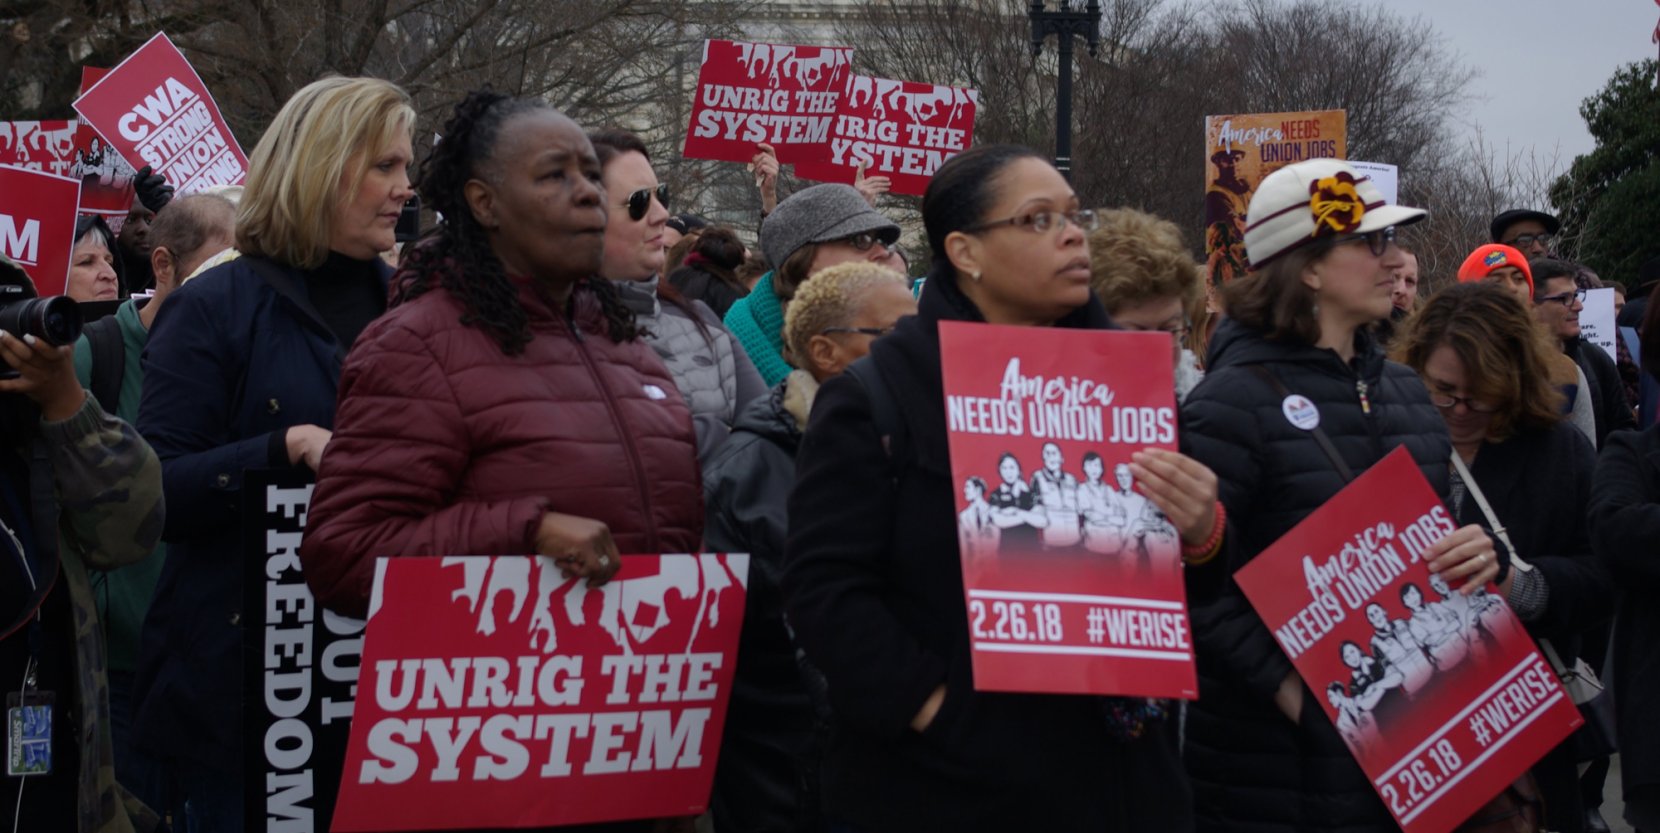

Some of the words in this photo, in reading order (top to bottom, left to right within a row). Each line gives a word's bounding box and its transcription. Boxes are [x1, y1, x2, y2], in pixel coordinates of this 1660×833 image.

[118, 77, 195, 141] CWA
[703, 83, 790, 113] UNRIG
[795, 91, 840, 114] THE
[140, 101, 213, 167] STRONG
[694, 109, 833, 144] SYSTEM
[906, 123, 965, 150] THE
[1218, 119, 1284, 155] America
[1281, 119, 1320, 140] NEEDS
[1261, 142, 1300, 163] UNION
[1305, 140, 1336, 160] JOBS
[163, 128, 227, 188] UNION
[180, 150, 242, 197] RONG
[1000, 357, 1115, 408] America
[947, 395, 1024, 436] NEEDS
[1028, 400, 1103, 442] UNION
[1109, 406, 1175, 444] JOBS
[1275, 592, 1345, 659] NEEDS
[1336, 541, 1407, 611] UNION
[1398, 504, 1454, 565] JOBS
[1302, 520, 1396, 594] America
[969, 599, 1063, 642] 2.26.18
[1086, 606, 1190, 649] #WERISE
[264, 484, 314, 833] FREEDOM
[375, 655, 585, 711] UNRIG
[601, 652, 723, 704] THE
[358, 707, 712, 784] SYSTEM
[1380, 738, 1463, 817] 2.26.18
[1469, 661, 1559, 747] #WERISE
